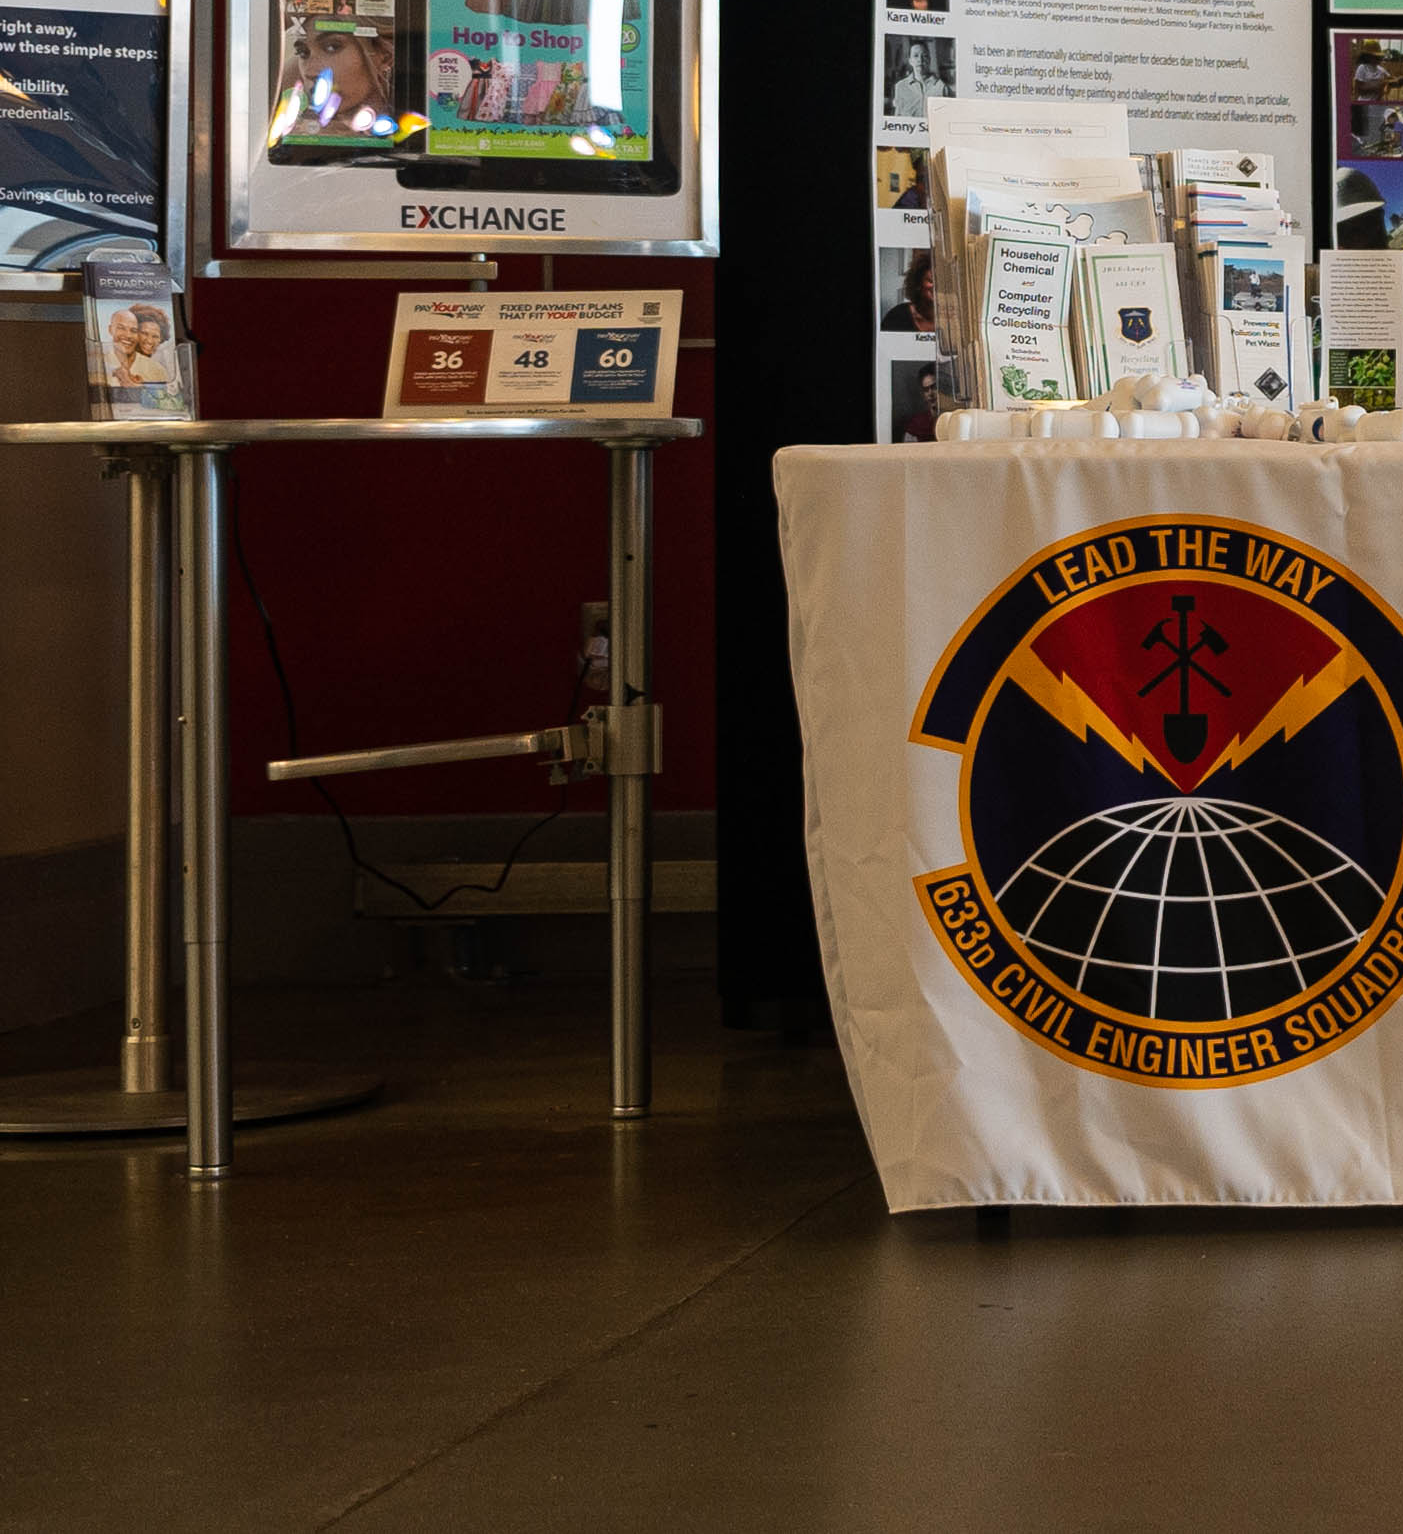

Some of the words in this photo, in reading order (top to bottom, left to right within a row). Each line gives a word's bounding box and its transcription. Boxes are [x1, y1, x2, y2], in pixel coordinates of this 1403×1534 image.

[887, 12, 908, 23] Kara
[911, 13, 945, 26] Walker
[35, 24, 77, 38] away,
[19, 41, 60, 56] these
[63, 43, 111, 60] simple
[115, 47, 158, 61] steps:
[1014, 67, 1047, 79] paintings
[1070, 68, 1093, 80] female
[54, 188, 85, 203] Club
[107, 192, 154, 205] receive
[401, 205, 566, 231] EXCHANGE
[1001, 248, 1060, 263] Household
[1003, 262, 1054, 276] Chemical
[999, 290, 1053, 303] Computer
[501, 304, 532, 312] FIXED
[535, 303, 586, 311] PAYMENT
[589, 302, 623, 310] PLANS
[998, 303, 1050, 319] Recycling
[579, 311, 624, 319] BUDGET
[992, 317, 1054, 331] Collections
[1011, 335, 1038, 345] 2021
[431, 350, 463, 369] 36
[514, 350, 549, 368] 48
[599, 349, 633, 367] 60
[1032, 537, 1137, 605] LEAD
[1149, 529, 1231, 568] THE
[1245, 535, 1337, 605] WAY
[991, 962, 1078, 1048] CIVIL
[1086, 1026, 1280, 1078] ENGINEER
